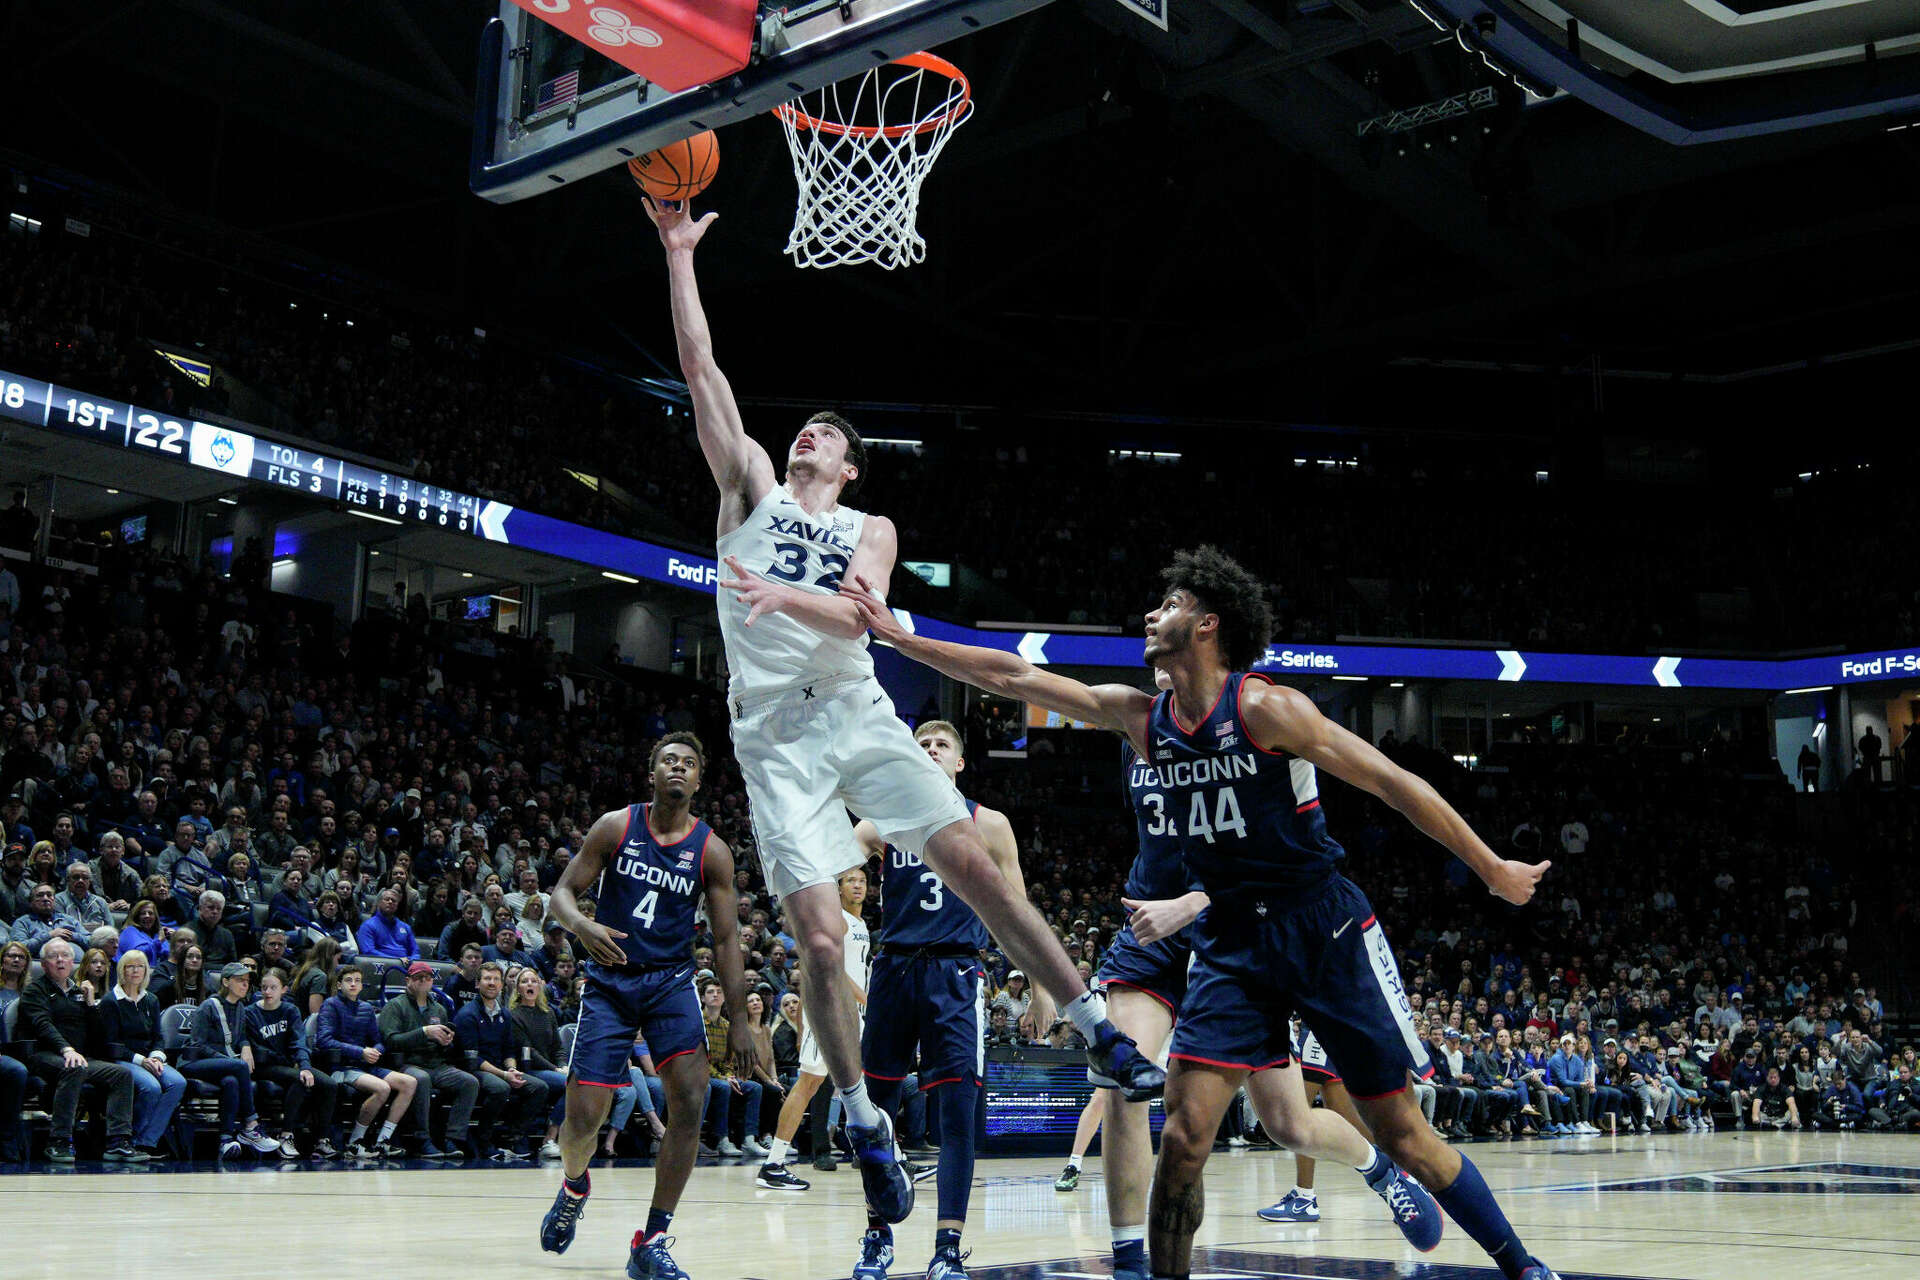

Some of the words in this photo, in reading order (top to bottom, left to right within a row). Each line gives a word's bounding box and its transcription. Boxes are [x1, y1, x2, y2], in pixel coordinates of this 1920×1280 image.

[66, 399, 114, 431] 1ST
[134, 414, 184, 454] 22
[268, 464, 300, 487] FLS
[309, 475, 321, 492] 3
[270, 444, 303, 468] TOL
[311, 457, 324, 473] 4
[346, 490, 367, 505] FLS
[379, 498, 385, 509] 1
[398, 503, 406, 515] 0
[418, 509, 427, 520] 0
[439, 514, 447, 526] 0
[459, 519, 467, 531] 0
[347, 478, 369, 493] PTS
[378, 486, 387, 498] 3
[399, 492, 408, 503] 0
[420, 497, 428, 508] 0
[440, 502, 448, 514] 4
[460, 507, 468, 519] 3
[381, 474, 388, 485] 2
[401, 480, 409, 491] 3
[421, 486, 429, 496] 4
[439, 490, 453, 503] 32
[458, 496, 473, 508] 44
[766, 515, 854, 559] XAVIE
[668, 558, 704, 583] Ford
[766, 542, 849, 592] 32
[1842, 657, 1882, 677] Ford
[1157, 754, 1257, 789] UCONN
[1188, 786, 1247, 844] 44
[616, 856, 695, 896] UCONN
[920, 871, 943, 911] 3
[632, 890, 659, 929] 4
